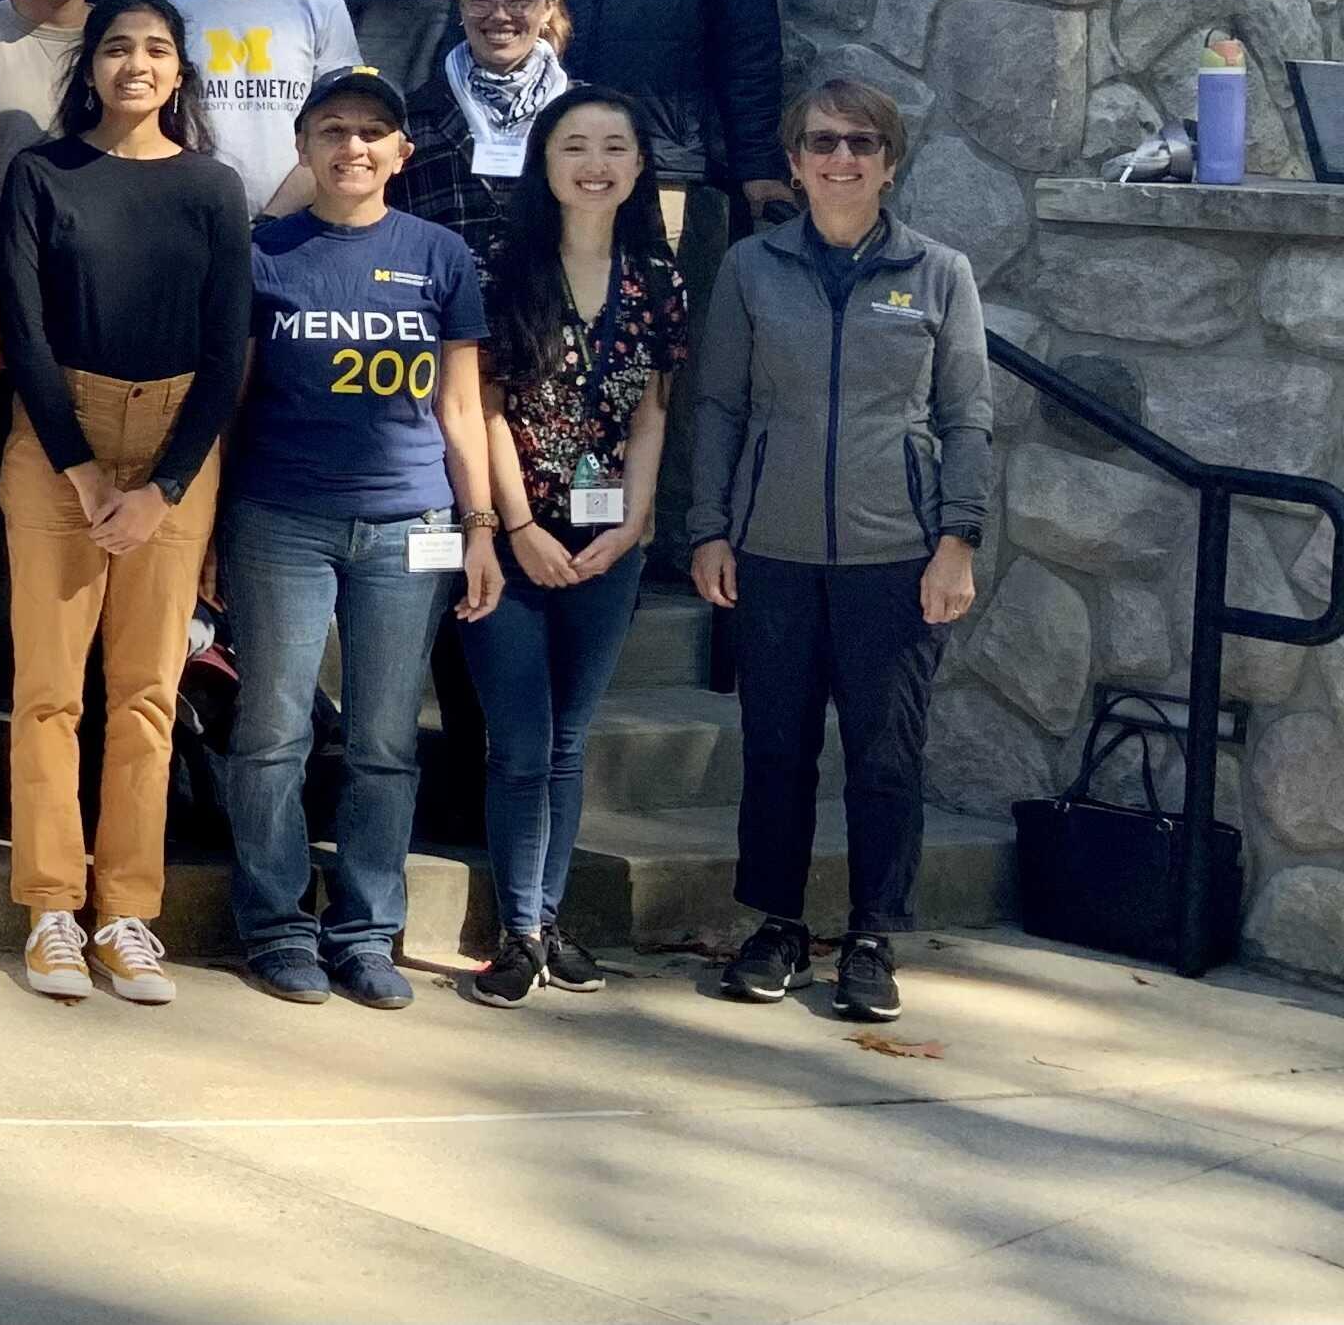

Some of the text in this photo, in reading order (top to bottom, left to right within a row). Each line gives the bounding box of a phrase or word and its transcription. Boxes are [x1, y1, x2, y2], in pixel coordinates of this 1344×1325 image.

[204, 26, 273, 72] M
[234, 79, 307, 101] GENETICS
[887, 289, 913, 307] M
[271, 310, 437, 343] MENDEL
[330, 348, 436, 399] 200
